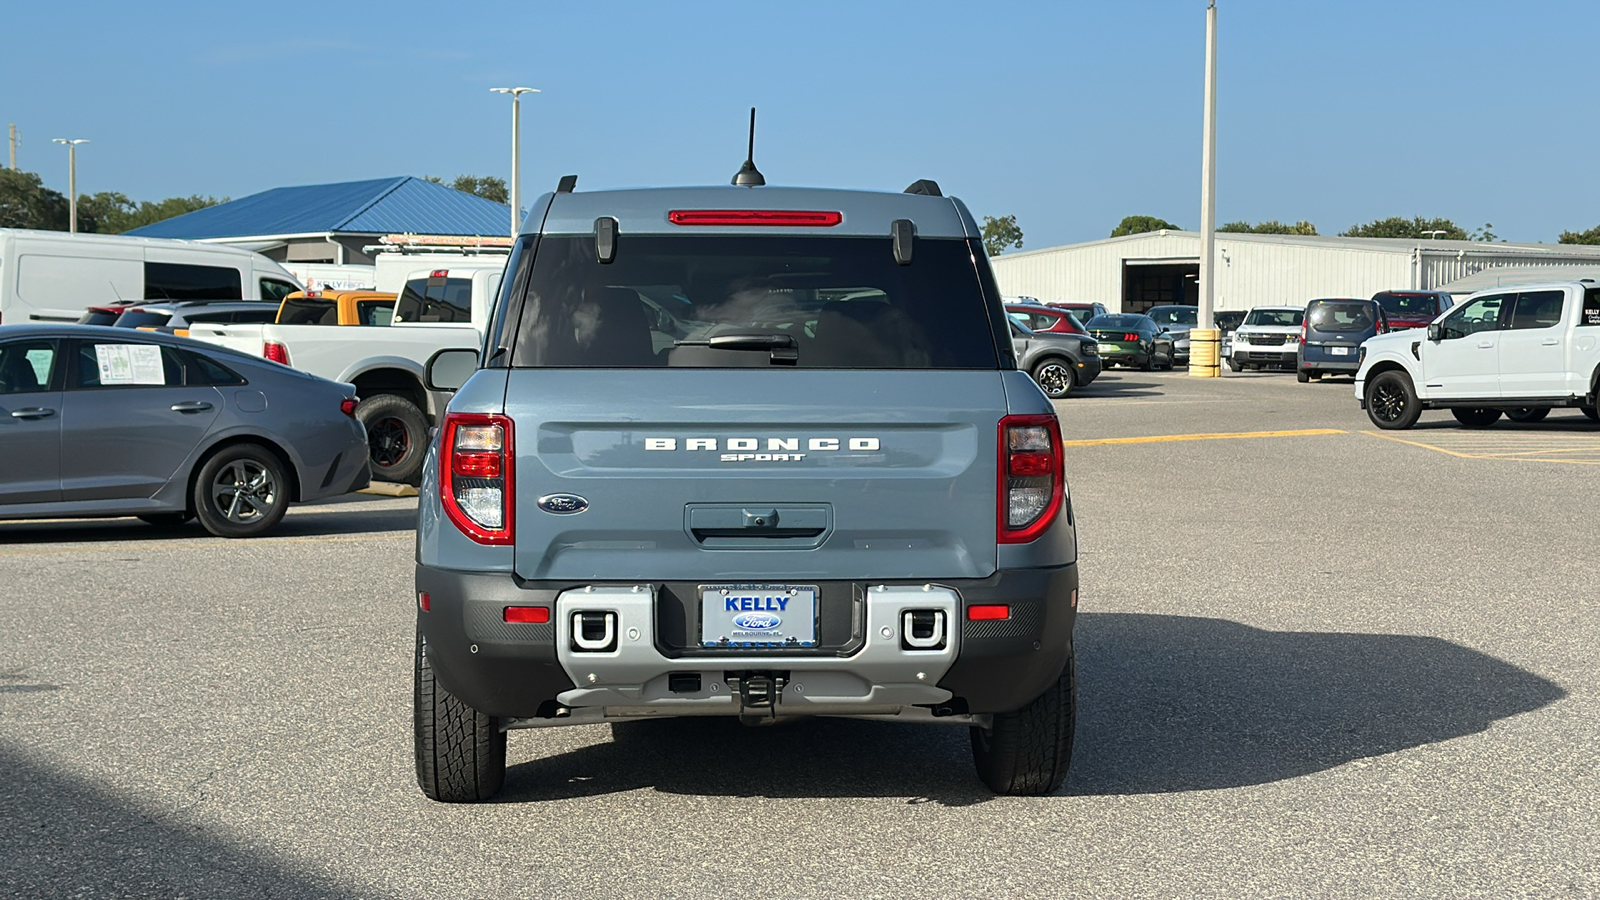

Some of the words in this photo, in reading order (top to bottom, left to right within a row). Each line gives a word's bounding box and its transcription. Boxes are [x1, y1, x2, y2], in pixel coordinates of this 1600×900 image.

[645, 438, 881, 451] BRONCO
[720, 453, 807, 462] SPORT
[725, 597, 790, 611] KELLY
[742, 615, 771, 627] Ford
